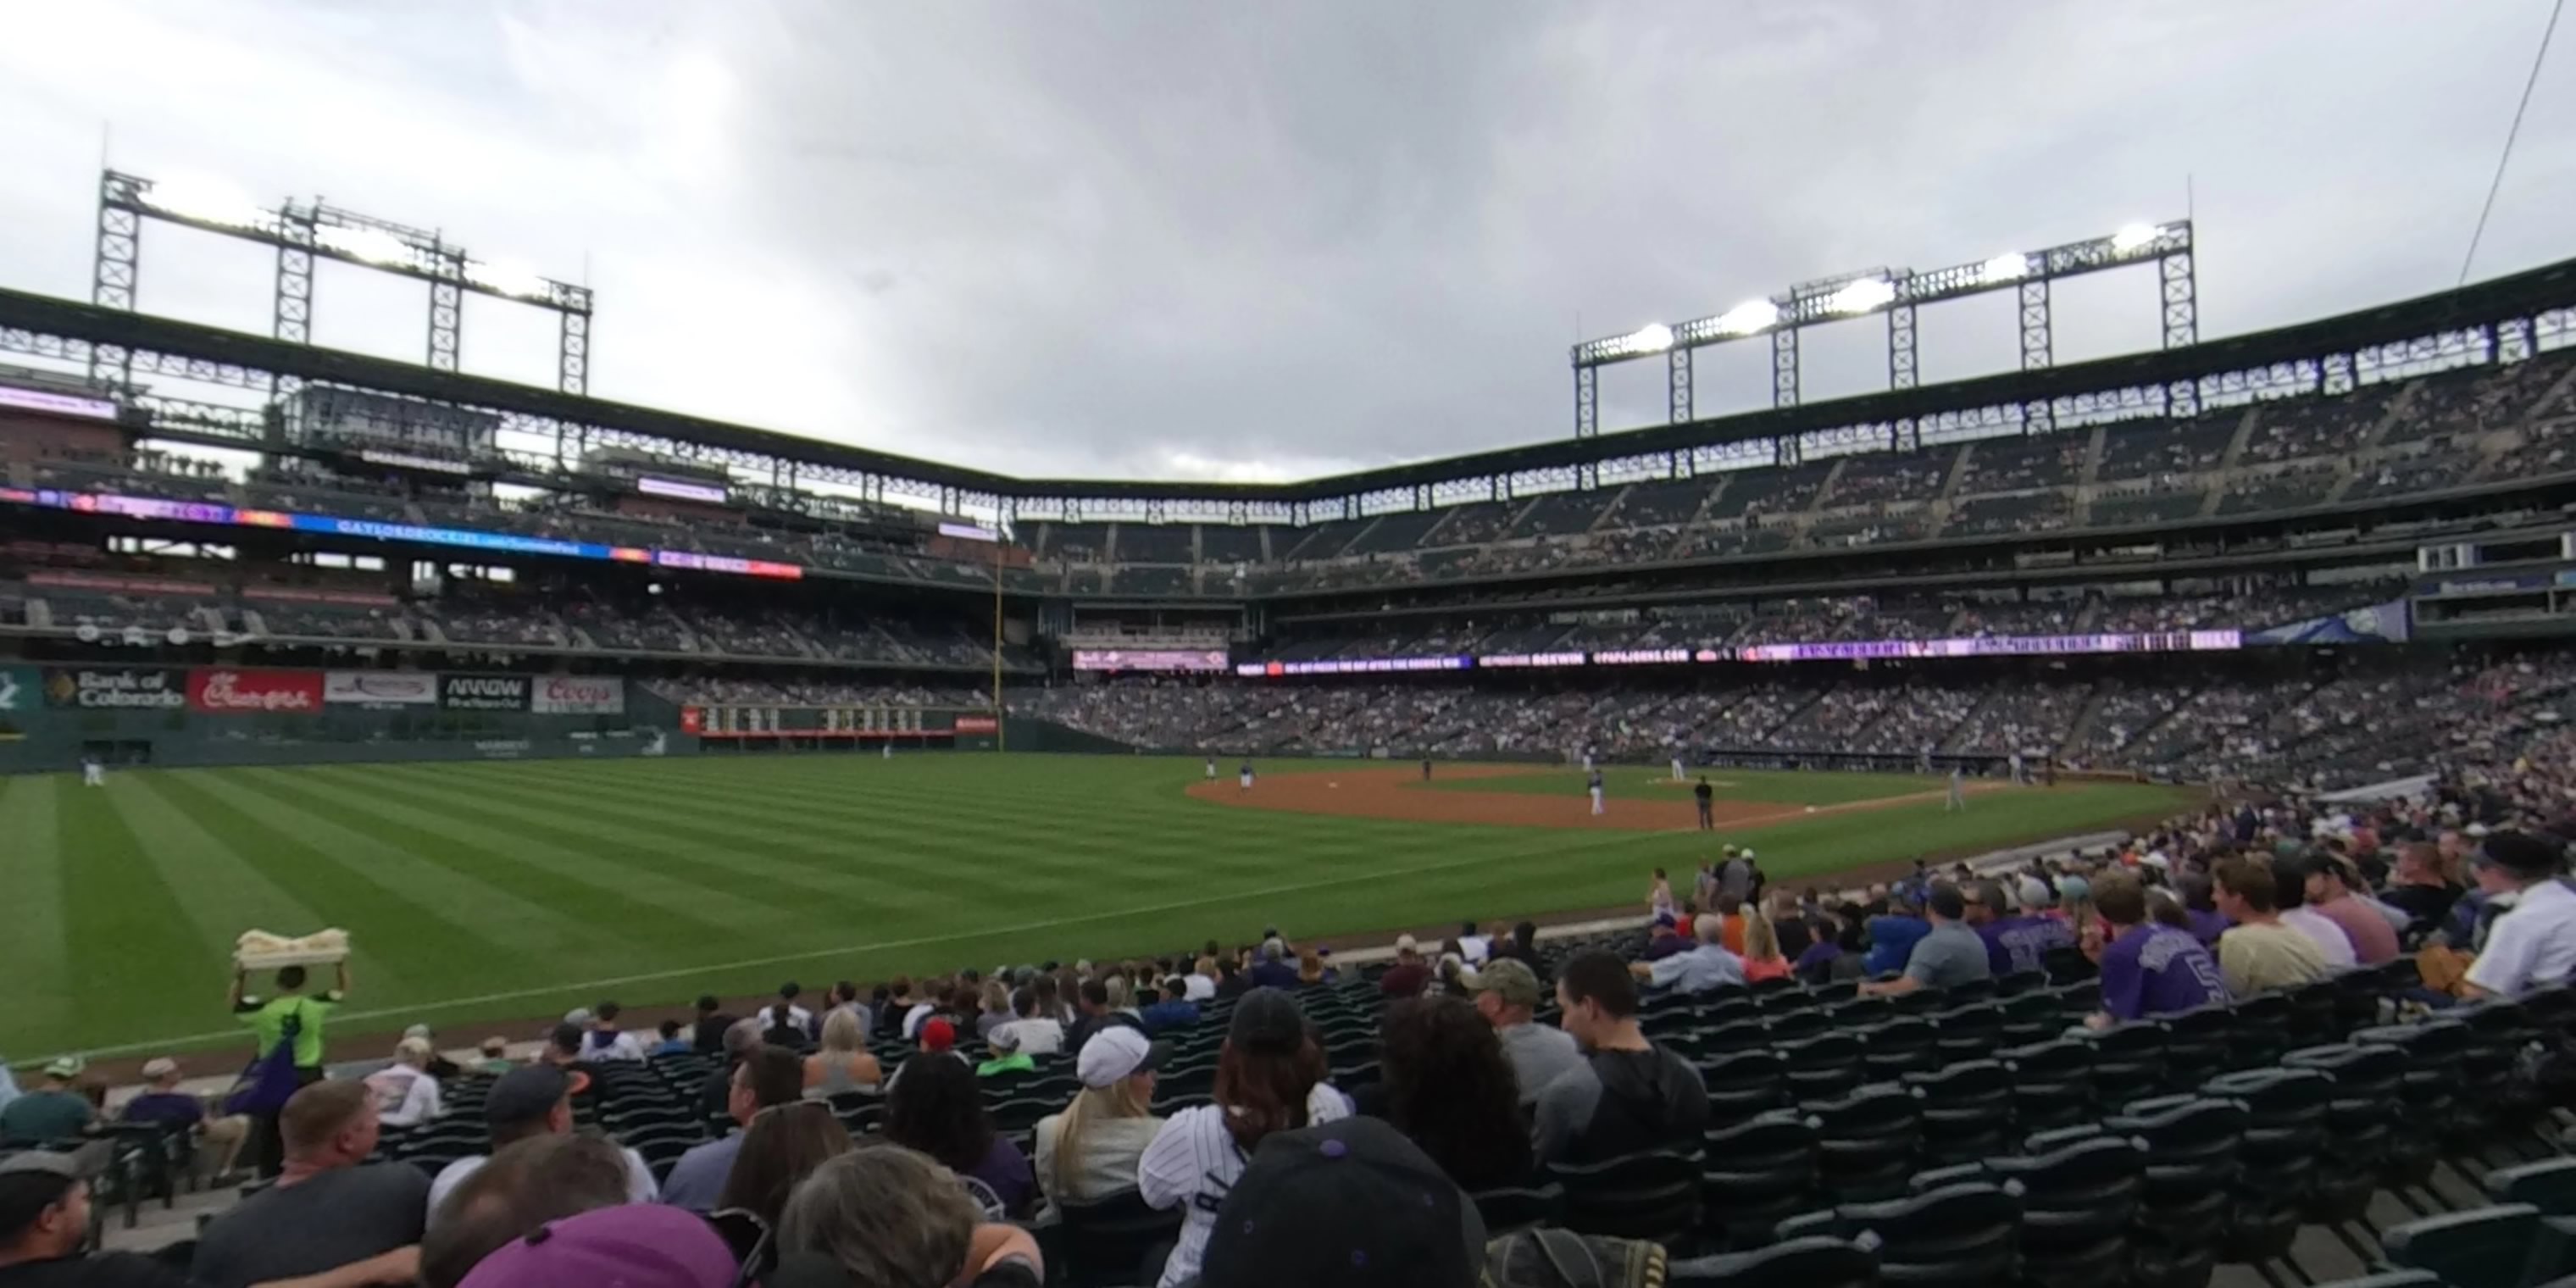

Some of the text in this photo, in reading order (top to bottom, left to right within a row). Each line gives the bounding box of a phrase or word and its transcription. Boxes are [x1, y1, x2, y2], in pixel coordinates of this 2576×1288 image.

[79, 670, 165, 689] Bank of
[447, 679, 522, 696] ARROW
[79, 688, 184, 707] Colorado
